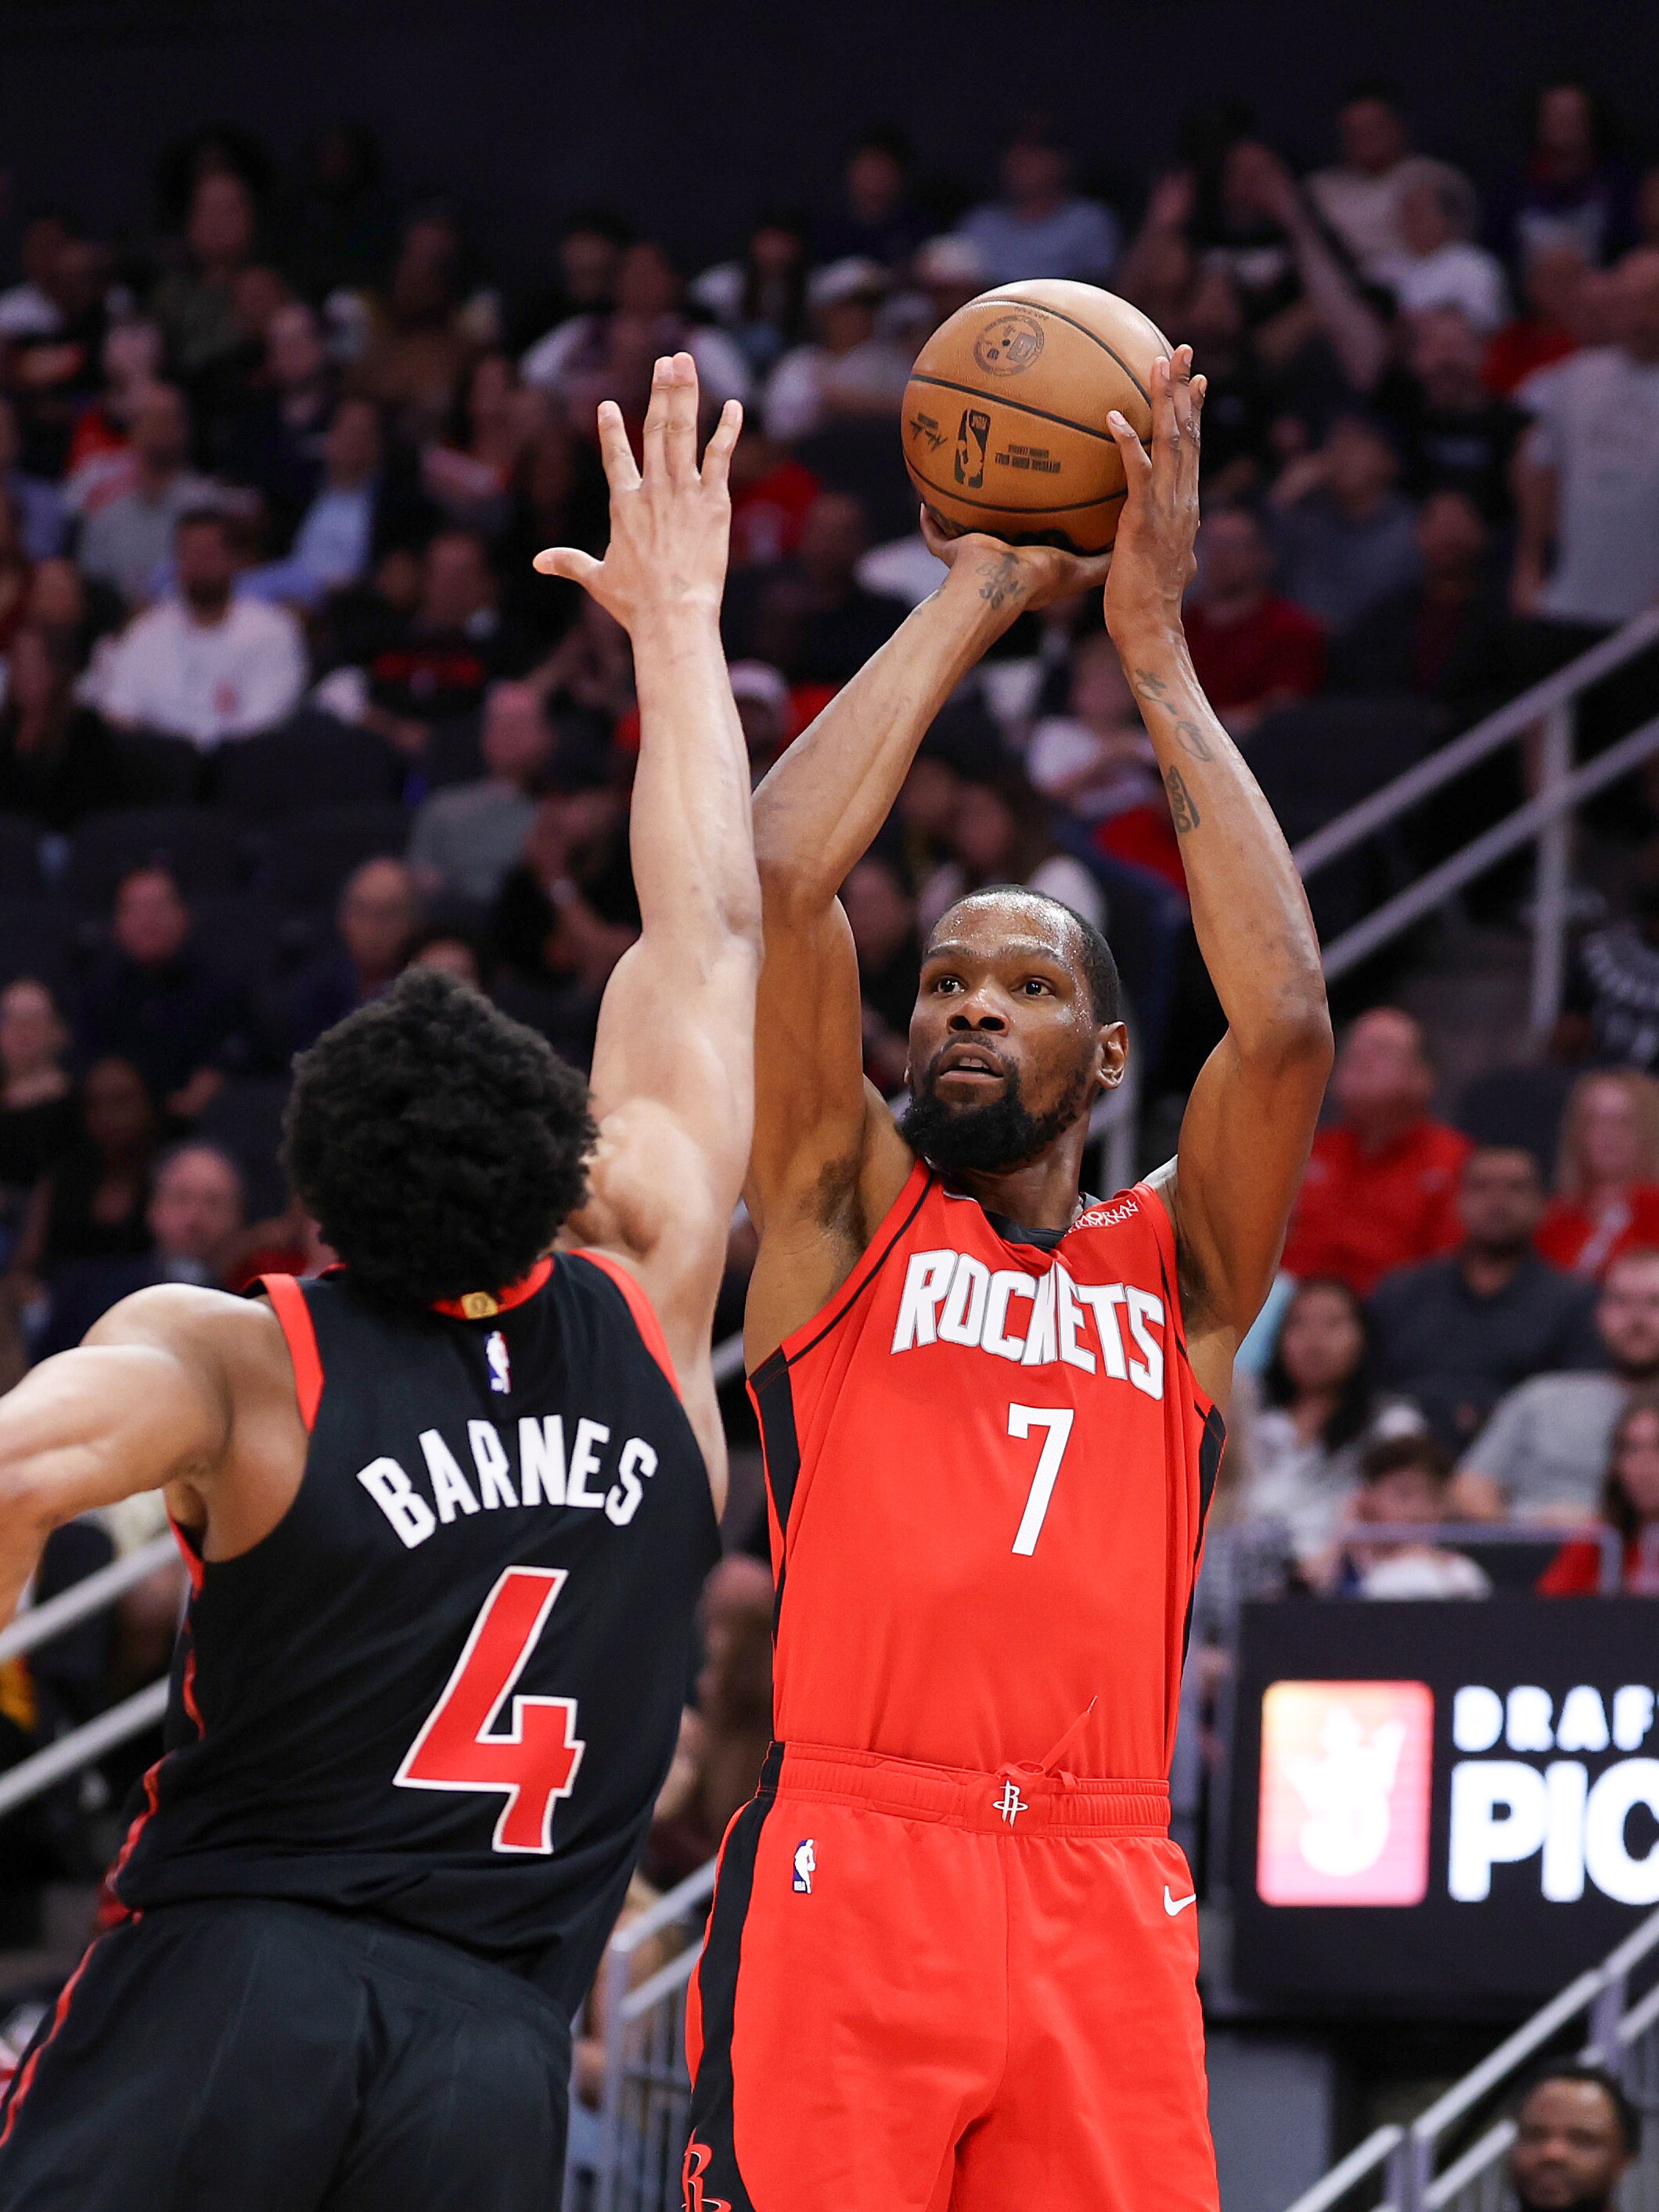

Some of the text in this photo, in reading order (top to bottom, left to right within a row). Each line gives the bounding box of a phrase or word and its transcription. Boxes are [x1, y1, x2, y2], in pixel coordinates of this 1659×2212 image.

[356, 1415, 658, 1549] BARNES
[1007, 1402, 1074, 1557] 7
[393, 1566, 585, 1854] 4
[1452, 1685, 1659, 1752] DRAF
